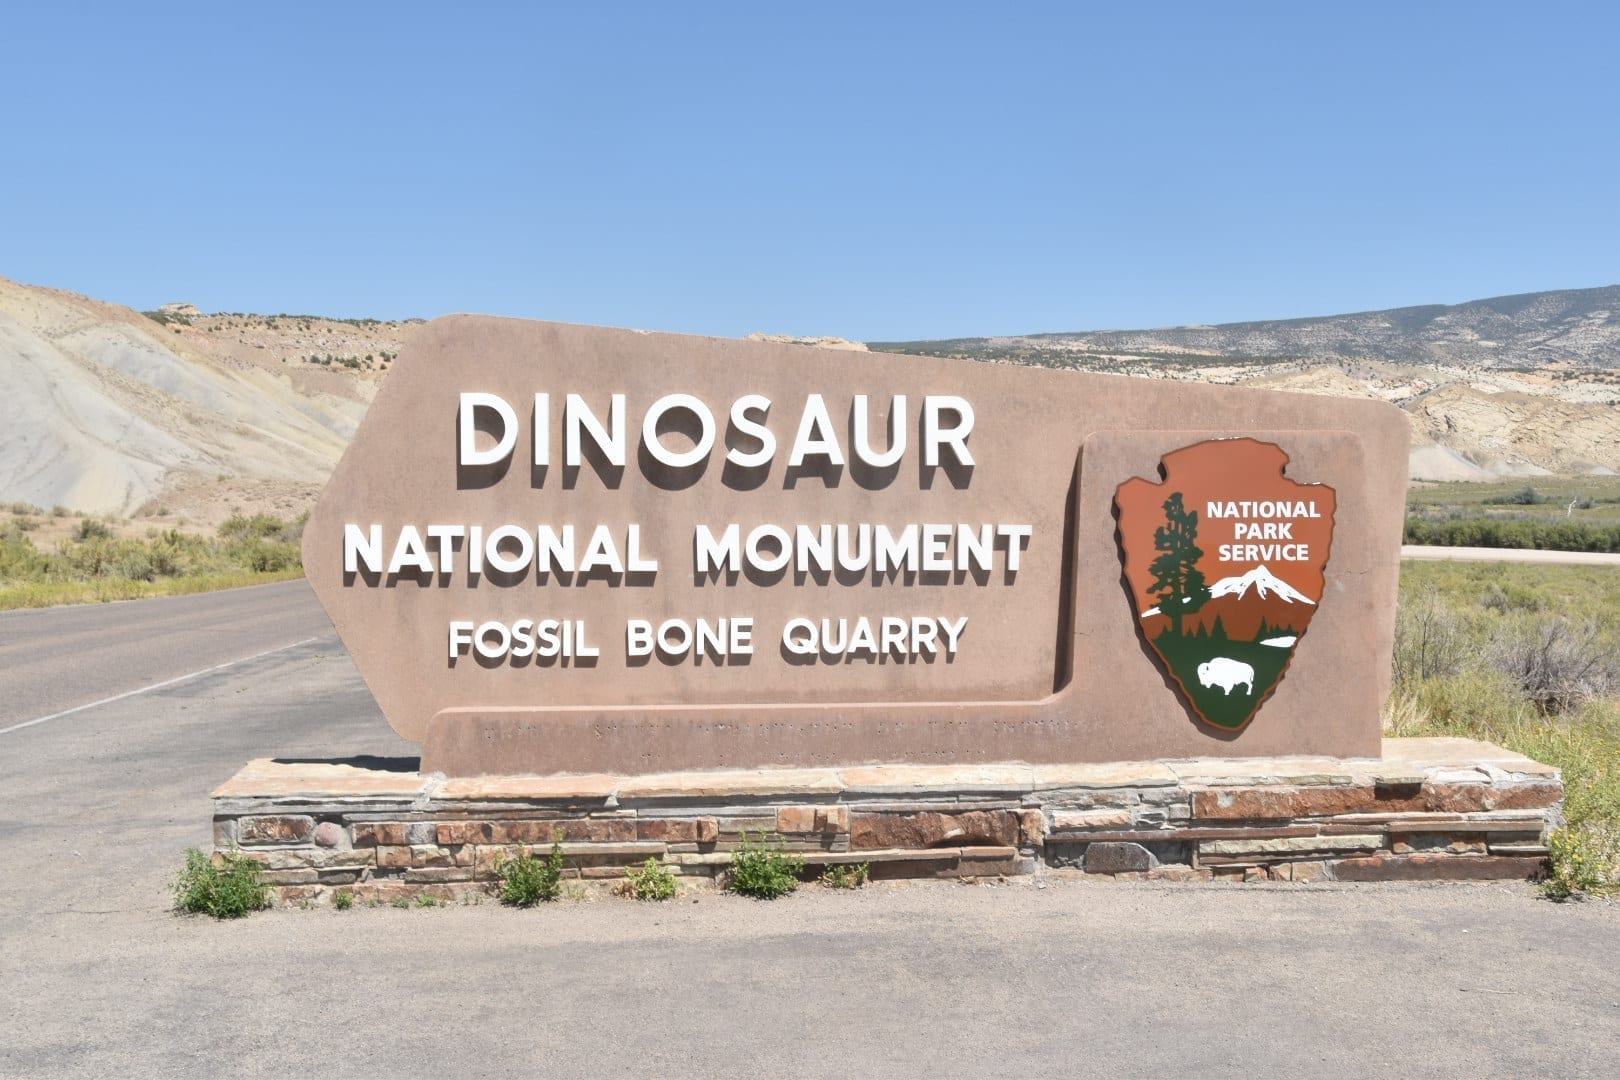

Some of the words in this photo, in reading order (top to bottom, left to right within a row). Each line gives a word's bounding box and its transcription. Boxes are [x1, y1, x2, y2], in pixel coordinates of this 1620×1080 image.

[459, 392, 976, 467] DINOSAUR
[1207, 501, 1321, 518] NATIONAL
[1234, 523, 1293, 539] PARK
[344, 523, 658, 573] NATIONAL
[695, 523, 1033, 572] MONUMENT
[1218, 544, 1309, 561] SERVICE
[449, 617, 600, 658] FOSSIL
[627, 616, 754, 657] BONE
[782, 615, 968, 656] QUARRY
